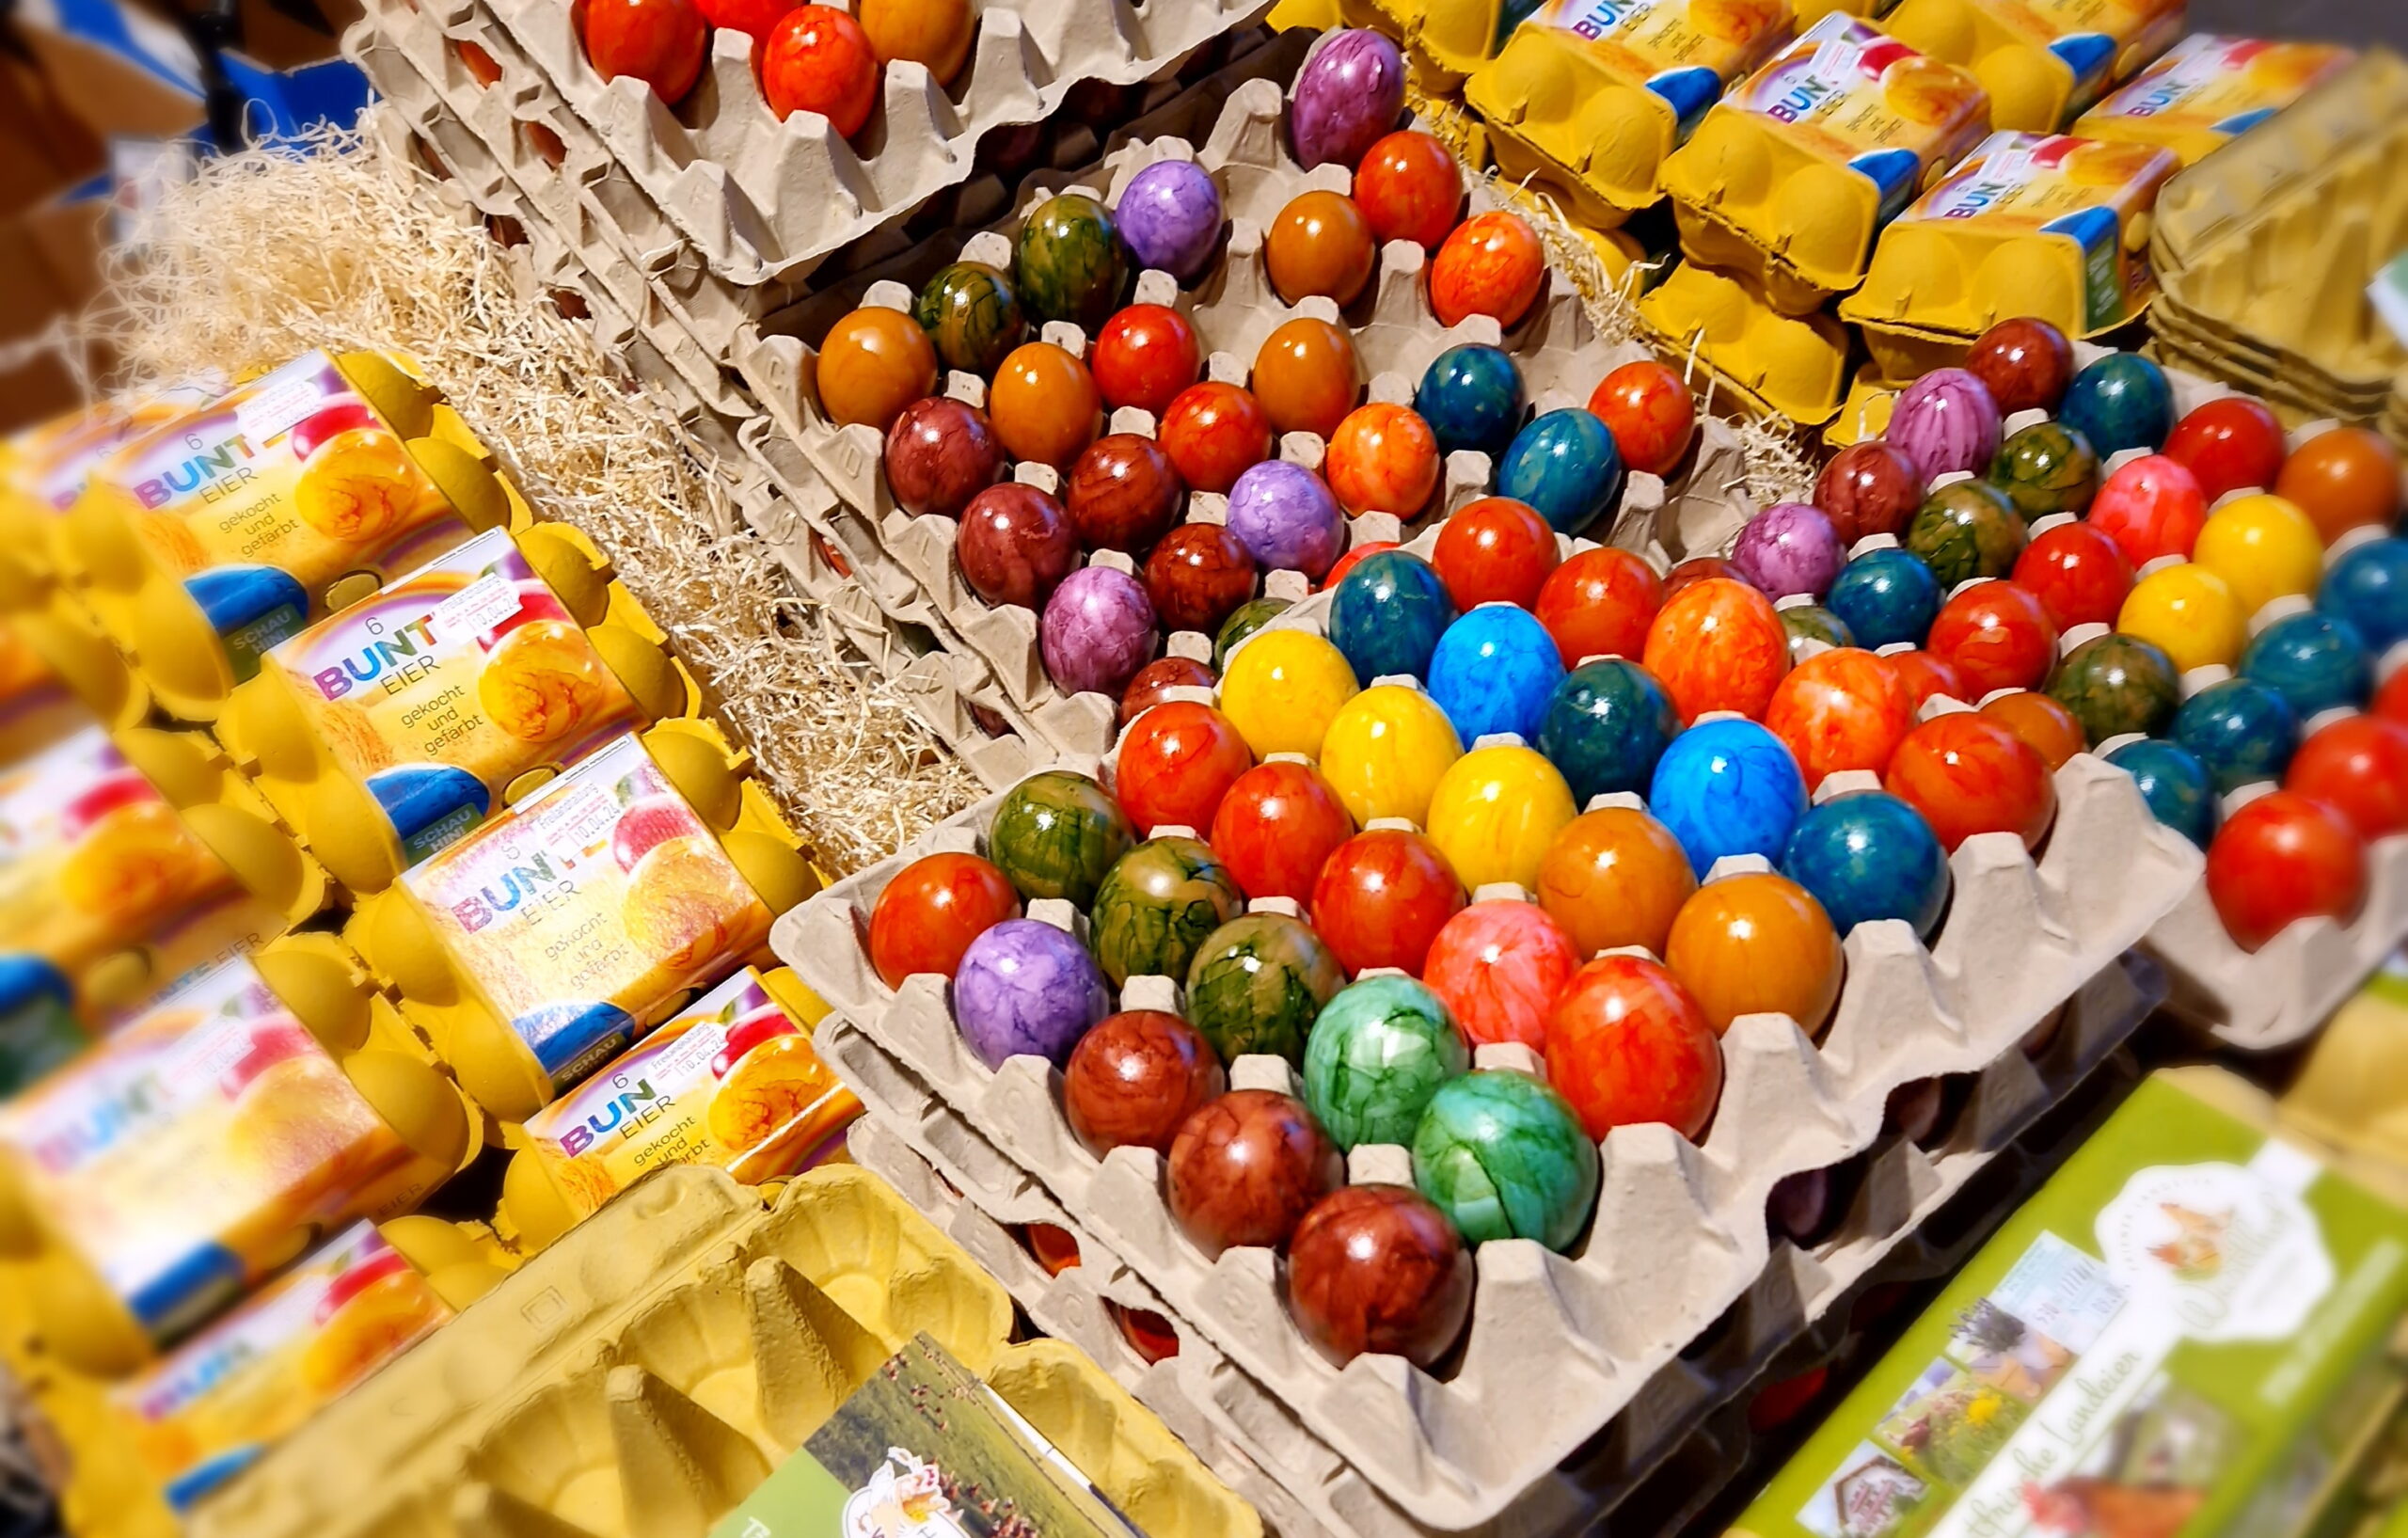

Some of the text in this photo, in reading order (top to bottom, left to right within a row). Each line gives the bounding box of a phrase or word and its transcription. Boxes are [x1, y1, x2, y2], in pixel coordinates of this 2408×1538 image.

[1572, 0, 1636, 41] BUN
[1766, 74, 1830, 124] BUN
[2125, 80, 2190, 117] BUN
[1943, 181, 2006, 218] BUN
[184, 433, 204, 451] 6
[134, 433, 256, 511] BUNT
[198, 467, 260, 505] EIER
[218, 492, 282, 534] gekocht
[244, 514, 276, 536] und
[240, 517, 299, 558] gefärbt
[232, 610, 292, 651] SCHAU
[365, 616, 384, 635] 6
[312, 613, 437, 702] BUNT
[380, 655, 441, 695] EIER
[400, 683, 467, 730] gekocht
[426, 706, 460, 732] und
[423, 713, 485, 757] gefärbt
[414, 810, 471, 849] SCHAU
[519, 880, 582, 927] EIER
[215, 931, 264, 965] EIER
[561, 1038, 617, 1082] SCHAU
[611, 1072, 629, 1089] 6
[559, 1078, 657, 1159] BUN
[618, 1094, 676, 1140] EIER
[633, 1115, 697, 1167] gekocht
[657, 1136, 689, 1165] und
